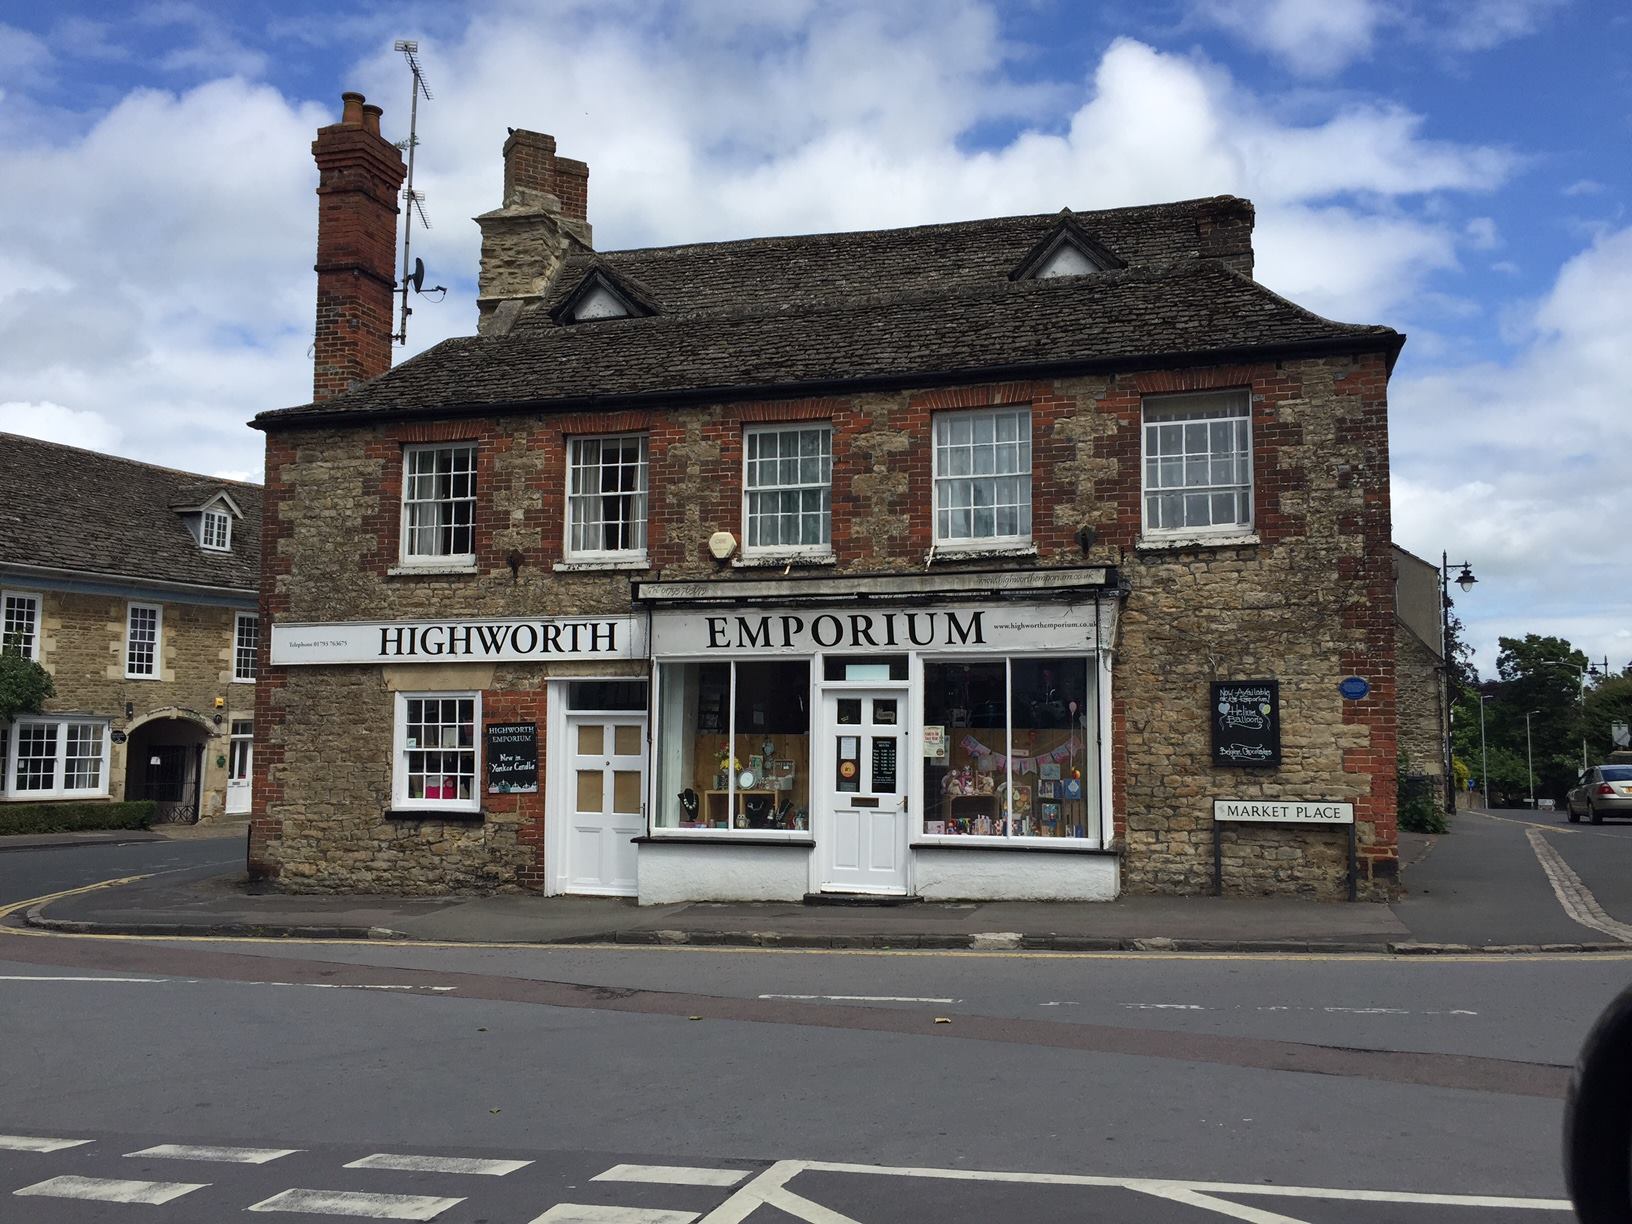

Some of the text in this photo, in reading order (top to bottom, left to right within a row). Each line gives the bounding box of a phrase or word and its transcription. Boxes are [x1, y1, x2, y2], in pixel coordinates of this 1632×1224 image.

[705, 611, 986, 648] EMPORIUM
[993, 621, 1097, 631] www.highworthemporium.co.uk
[378, 622, 618, 656] HIGHWORTH
[1226, 715, 1264, 724] Balloons
[489, 727, 535, 735] HIGHWORTH
[500, 754, 514, 762] New
[1226, 805, 1341, 819] MARKET PLACE
